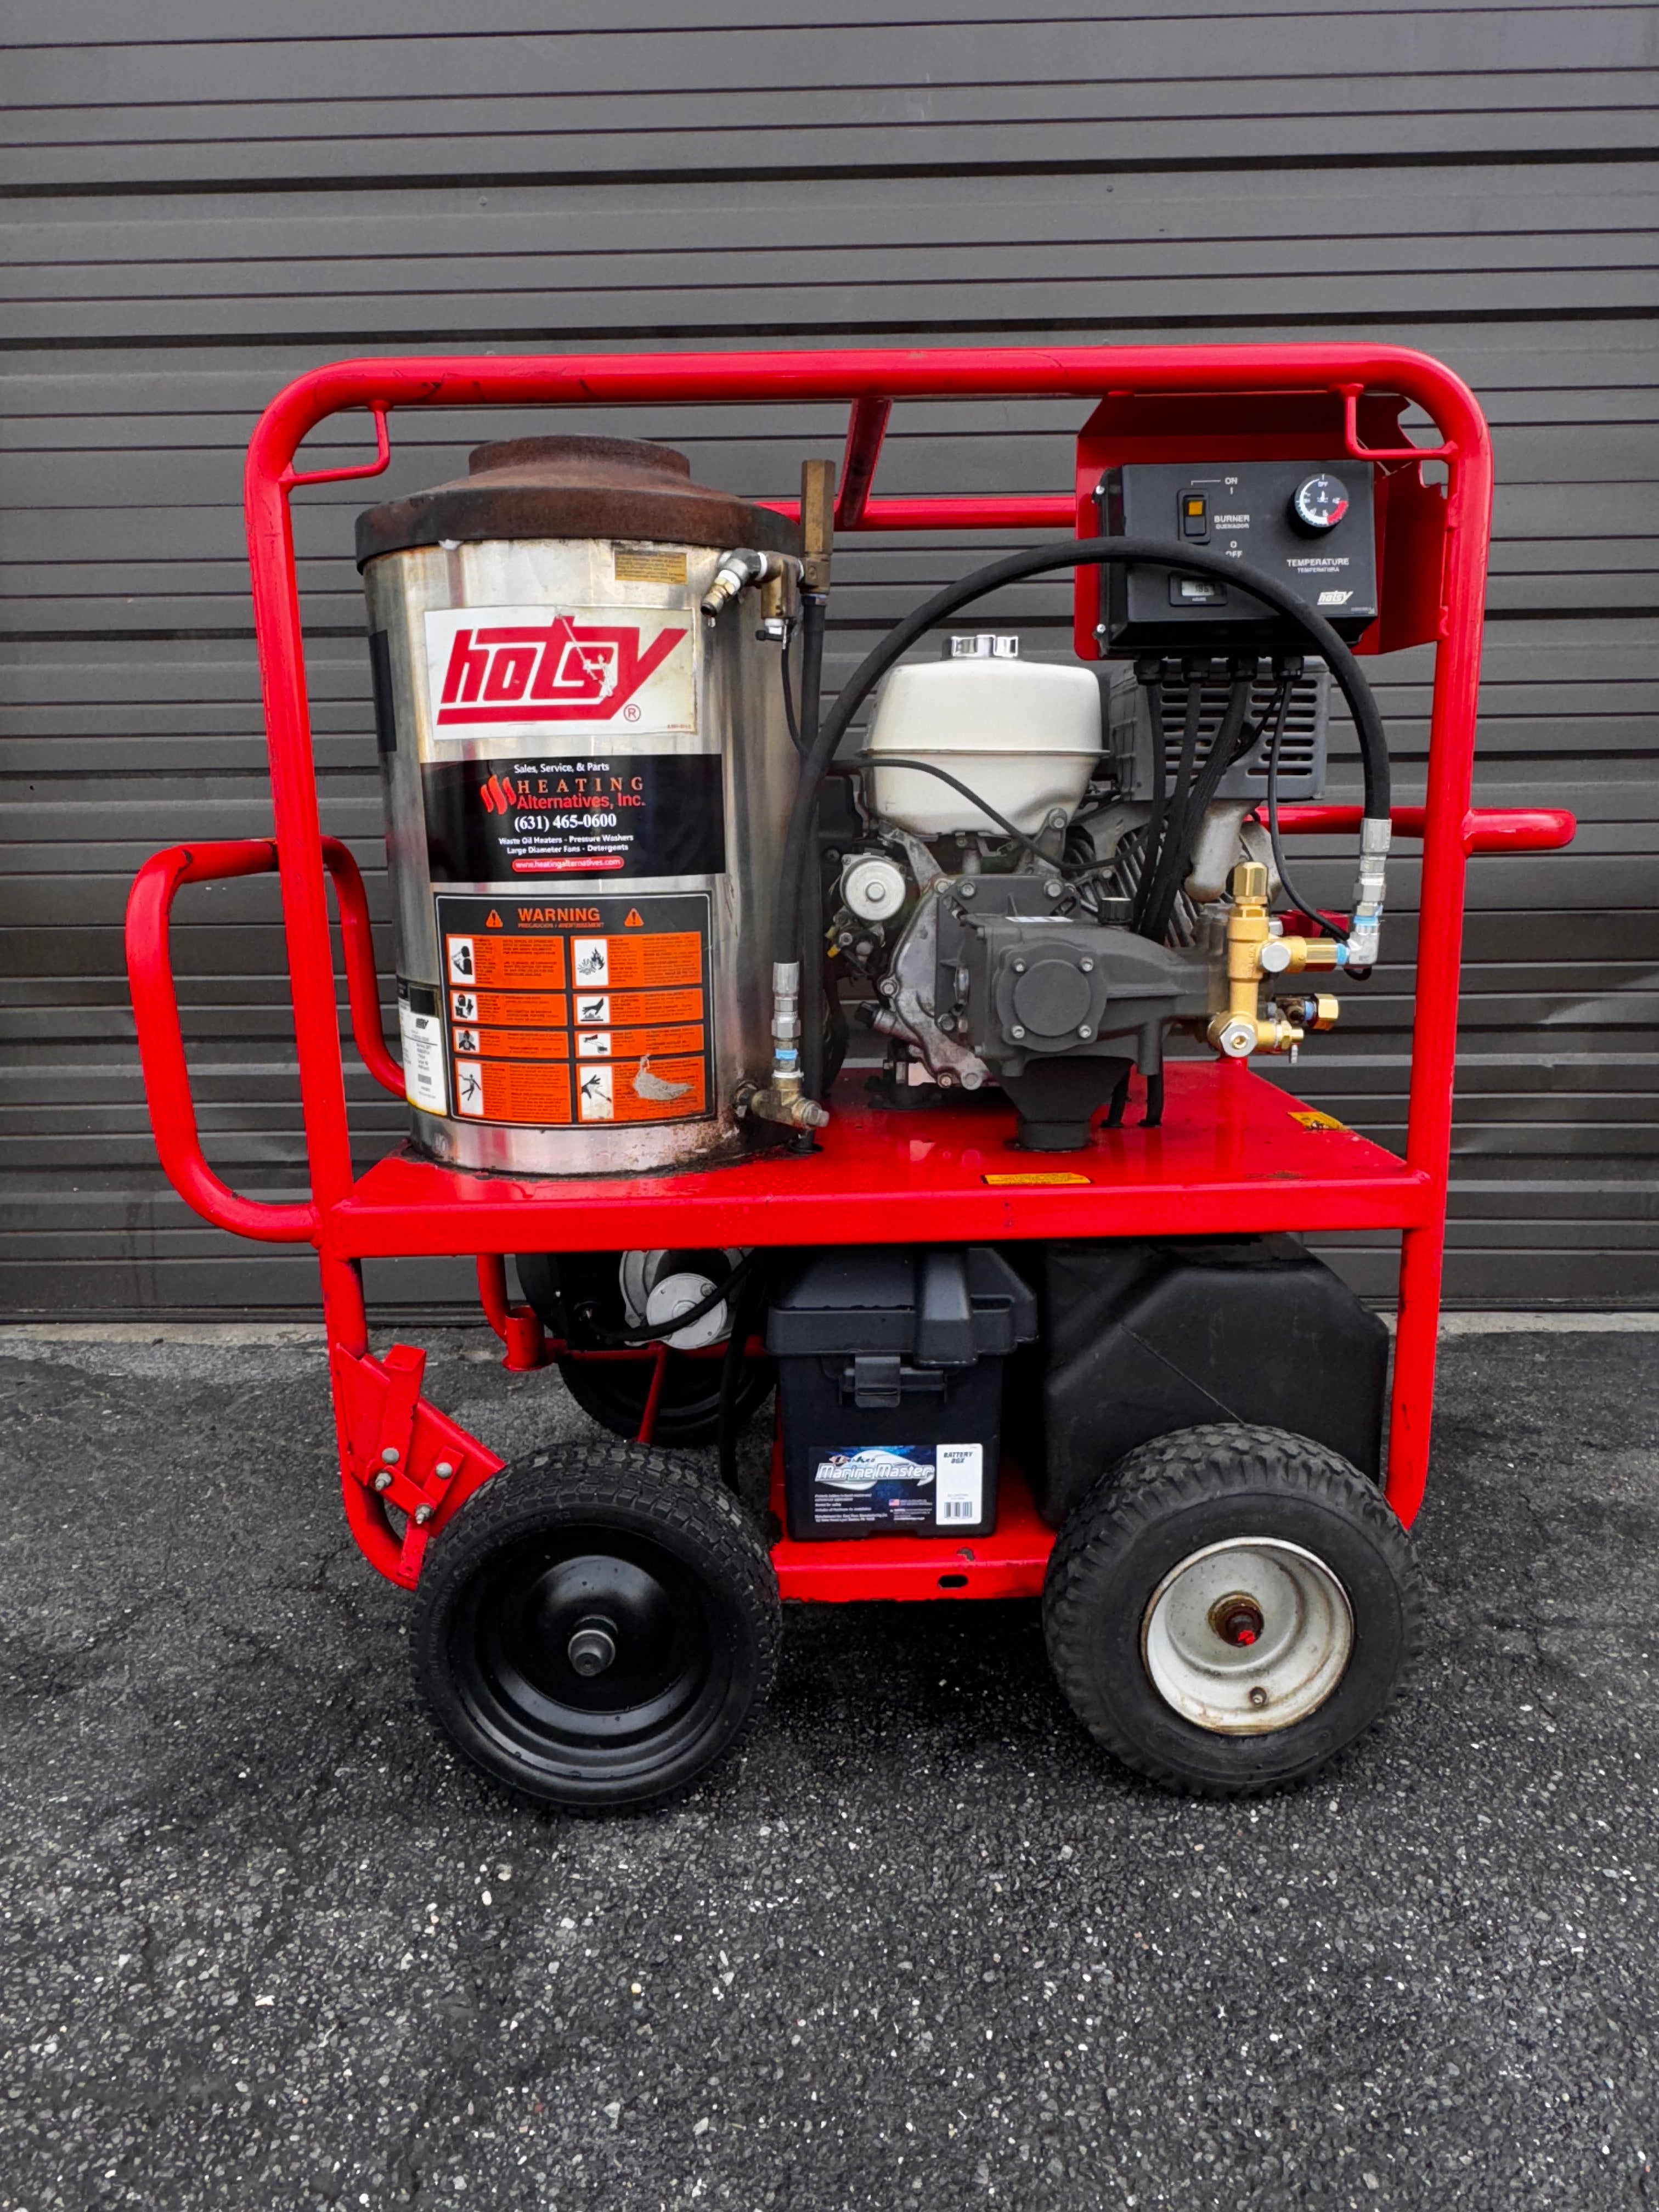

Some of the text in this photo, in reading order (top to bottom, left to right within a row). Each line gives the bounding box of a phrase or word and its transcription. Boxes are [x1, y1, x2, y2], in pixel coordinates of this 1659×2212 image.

[1224, 477, 1238, 485] ON
[1214, 515, 1250, 523] BURNER
[1286, 557, 1350, 567] TEMPERATURE
[514, 762, 610, 774] Sales, Service, & Parts
[517, 777, 644, 793] HEATING
[517, 792, 646, 810] Alternatives, Inc.
[514, 813, 617, 833] (631) 465-0600
[522, 837, 532, 845] Oil
[534, 836, 563, 844] Heaters
[569, 835, 600, 843] Pressure
[602, 833, 634, 842] Washers
[507, 847, 527, 856] Large
[587, 844, 629, 853] Detergents
[516, 859, 621, 870] www.heatingalternatives.com
[518, 907, 601, 922] WARNING
